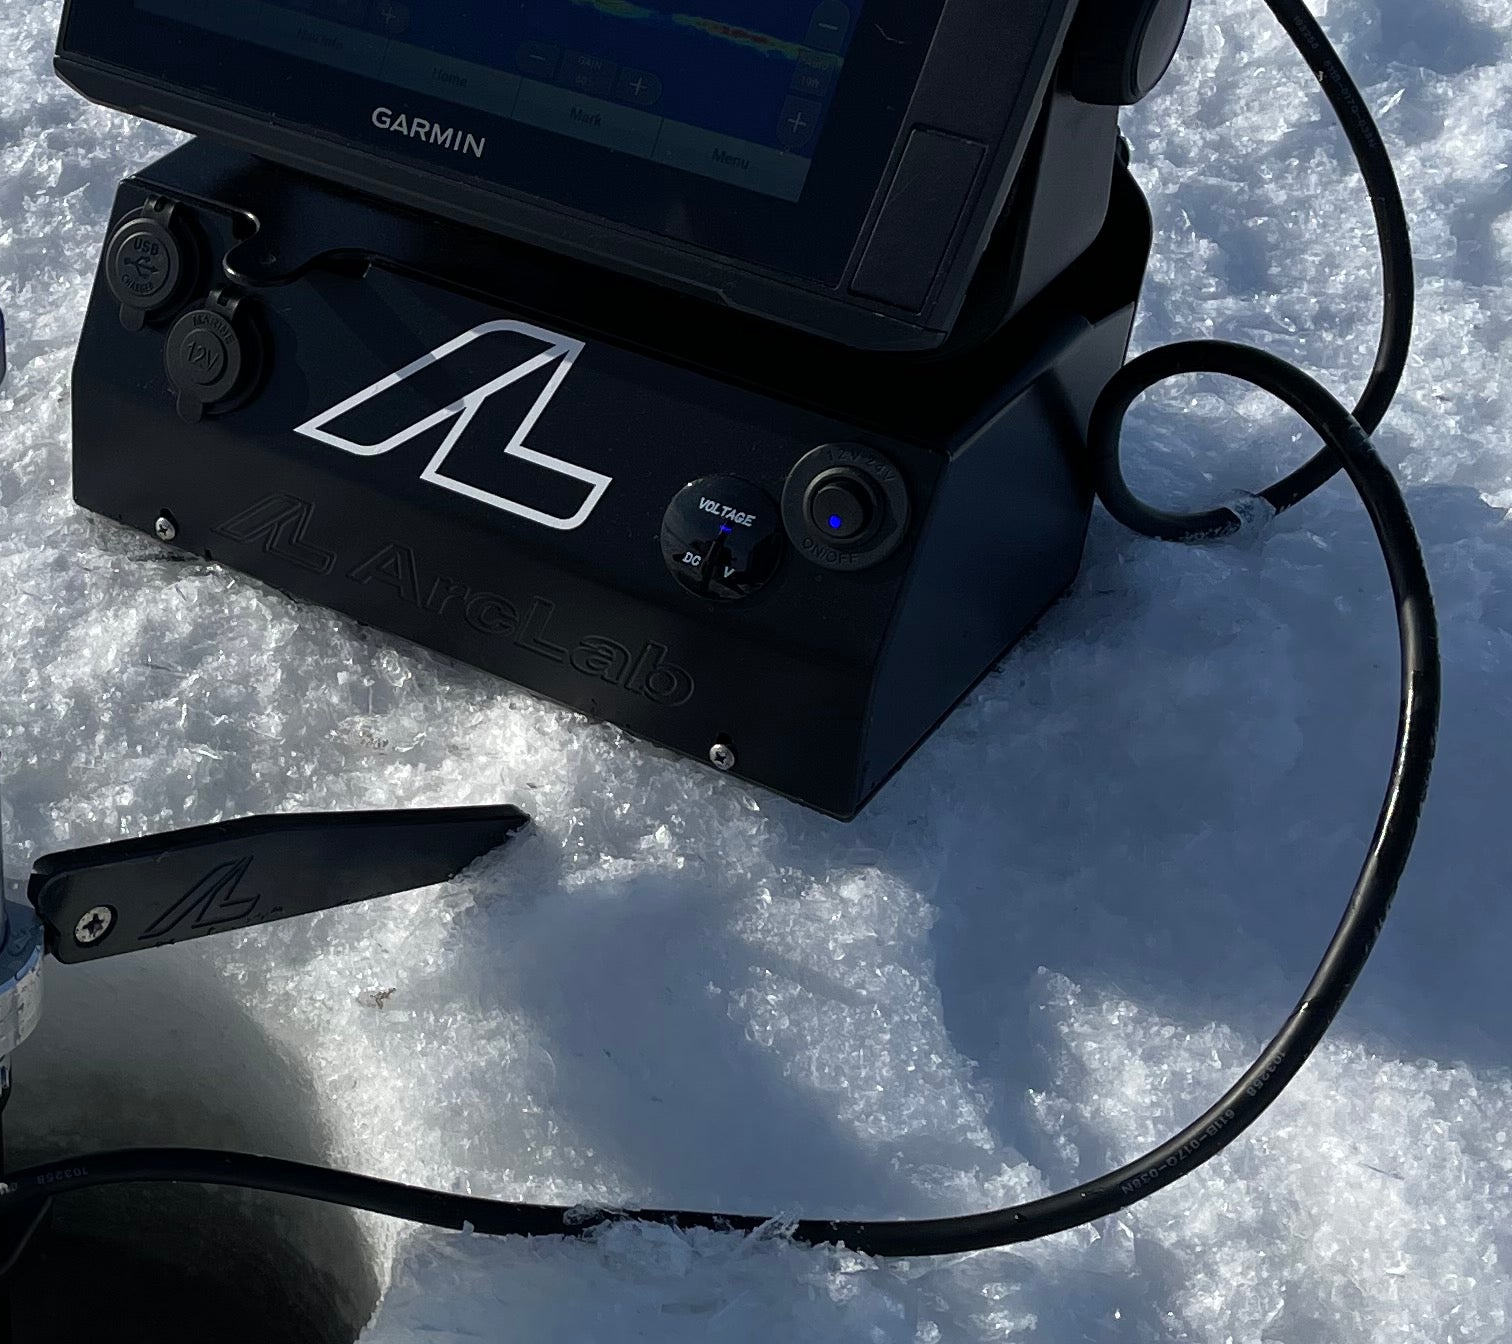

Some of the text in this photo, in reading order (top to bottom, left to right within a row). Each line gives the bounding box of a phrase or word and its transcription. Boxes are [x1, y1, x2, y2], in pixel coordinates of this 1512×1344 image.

[431, 67, 468, 89] Home
[569, 106, 603, 127] Mark
[370, 105, 488, 160] GARMIN
[711, 147, 750, 170] Menu
[133, 237, 160, 256] USB
[187, 341, 219, 371] 12V
[698, 496, 757, 527] VOLTAGE
[682, 551, 703, 567] DC
[801, 537, 862, 565] ON/OFF
[723, 566, 736, 579] V
[345, 542, 695, 708] ArcLab
[1245, 1051, 1287, 1098] 103258
